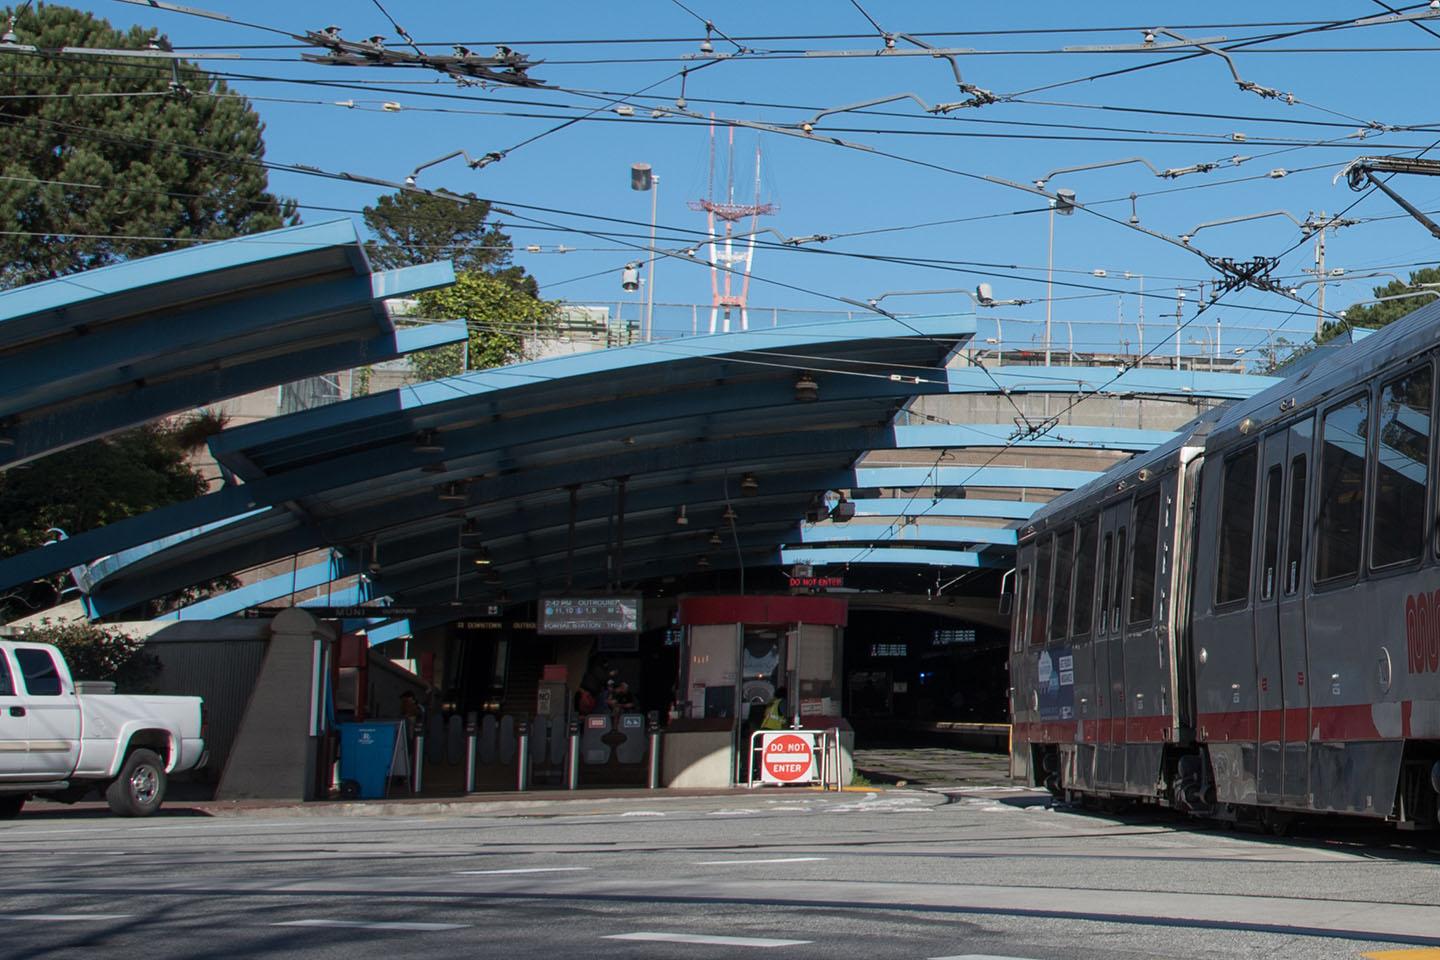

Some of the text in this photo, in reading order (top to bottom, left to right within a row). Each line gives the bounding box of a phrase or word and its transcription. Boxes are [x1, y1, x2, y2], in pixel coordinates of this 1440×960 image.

[790, 578, 843, 586] DO NOT ENTER
[336, 608, 365, 616] MUNI
[770, 743, 806, 752] DO NOT
[773, 764, 802, 773] ENTER
